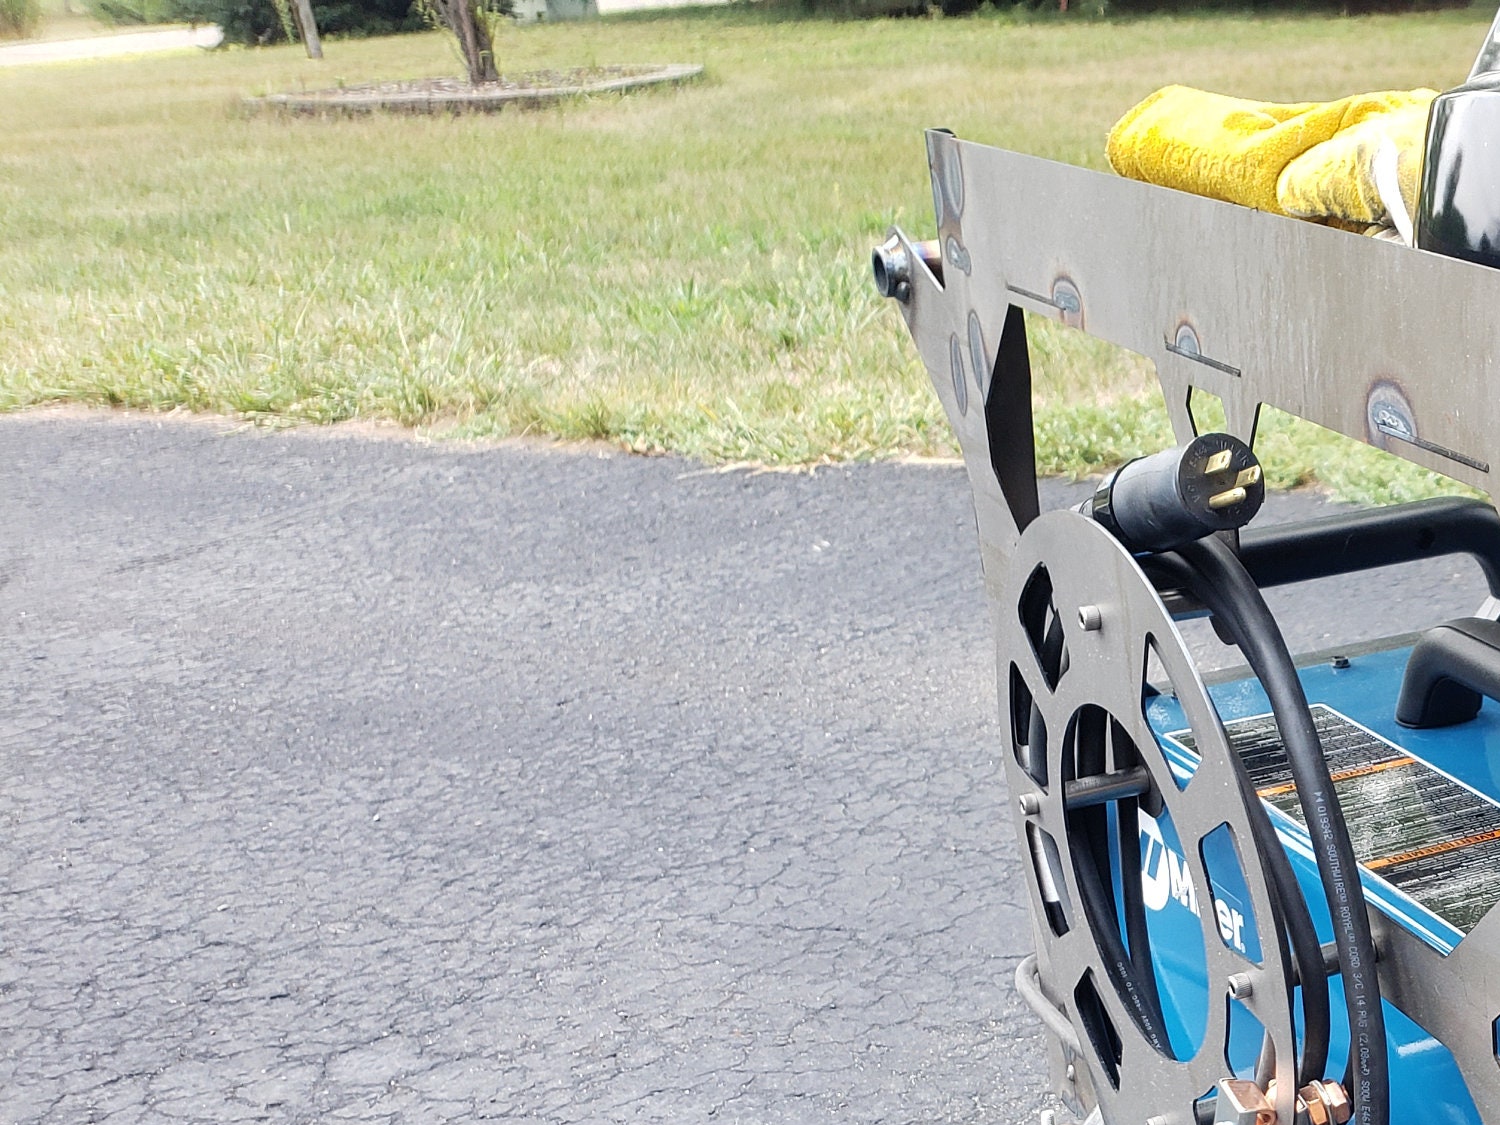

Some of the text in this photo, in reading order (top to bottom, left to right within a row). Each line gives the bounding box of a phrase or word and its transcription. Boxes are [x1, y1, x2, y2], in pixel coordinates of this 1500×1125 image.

[1348, 946, 1360, 969] CORD
[1125, 980, 1134, 992] TO
[1353, 972, 1364, 989] 3/C
[1356, 995, 1366, 1005] 14
